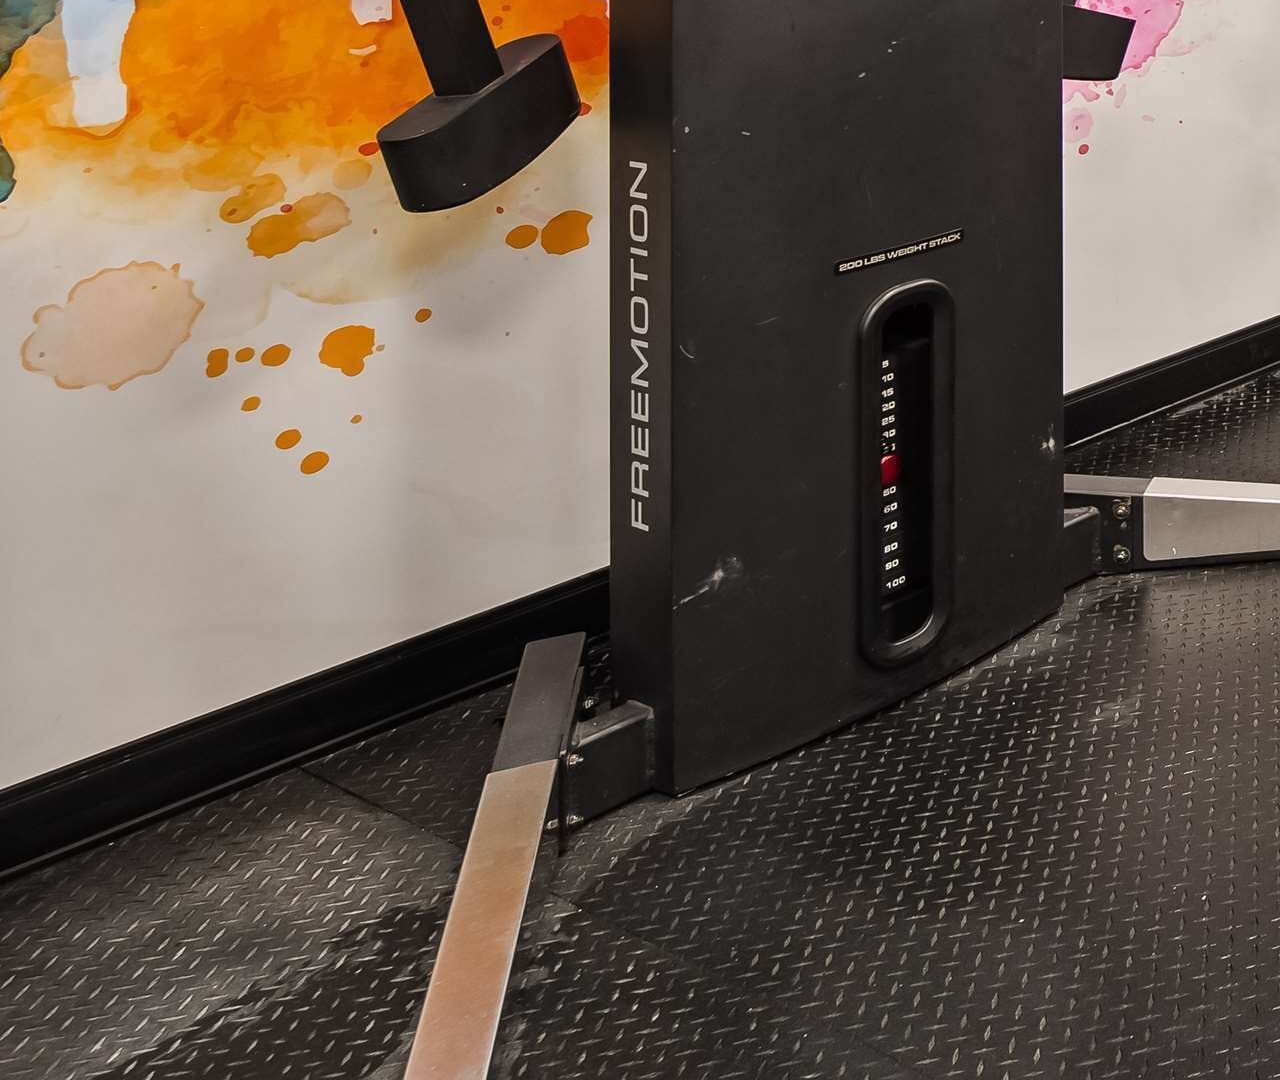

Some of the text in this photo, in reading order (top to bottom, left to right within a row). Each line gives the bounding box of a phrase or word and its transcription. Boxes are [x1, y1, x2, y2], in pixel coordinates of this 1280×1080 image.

[839, 233, 961, 272] 200 LBS WEIGHT STACK
[629, 160, 649, 532] FREEMOTION
[881, 359, 889, 369] 5
[881, 372, 895, 383] 10
[881, 387, 894, 398] 15
[881, 400, 896, 412] 20
[881, 414, 896, 426] 25
[883, 502, 898, 514] 60
[883, 521, 898, 533] 70
[886, 575, 906, 589] 100
